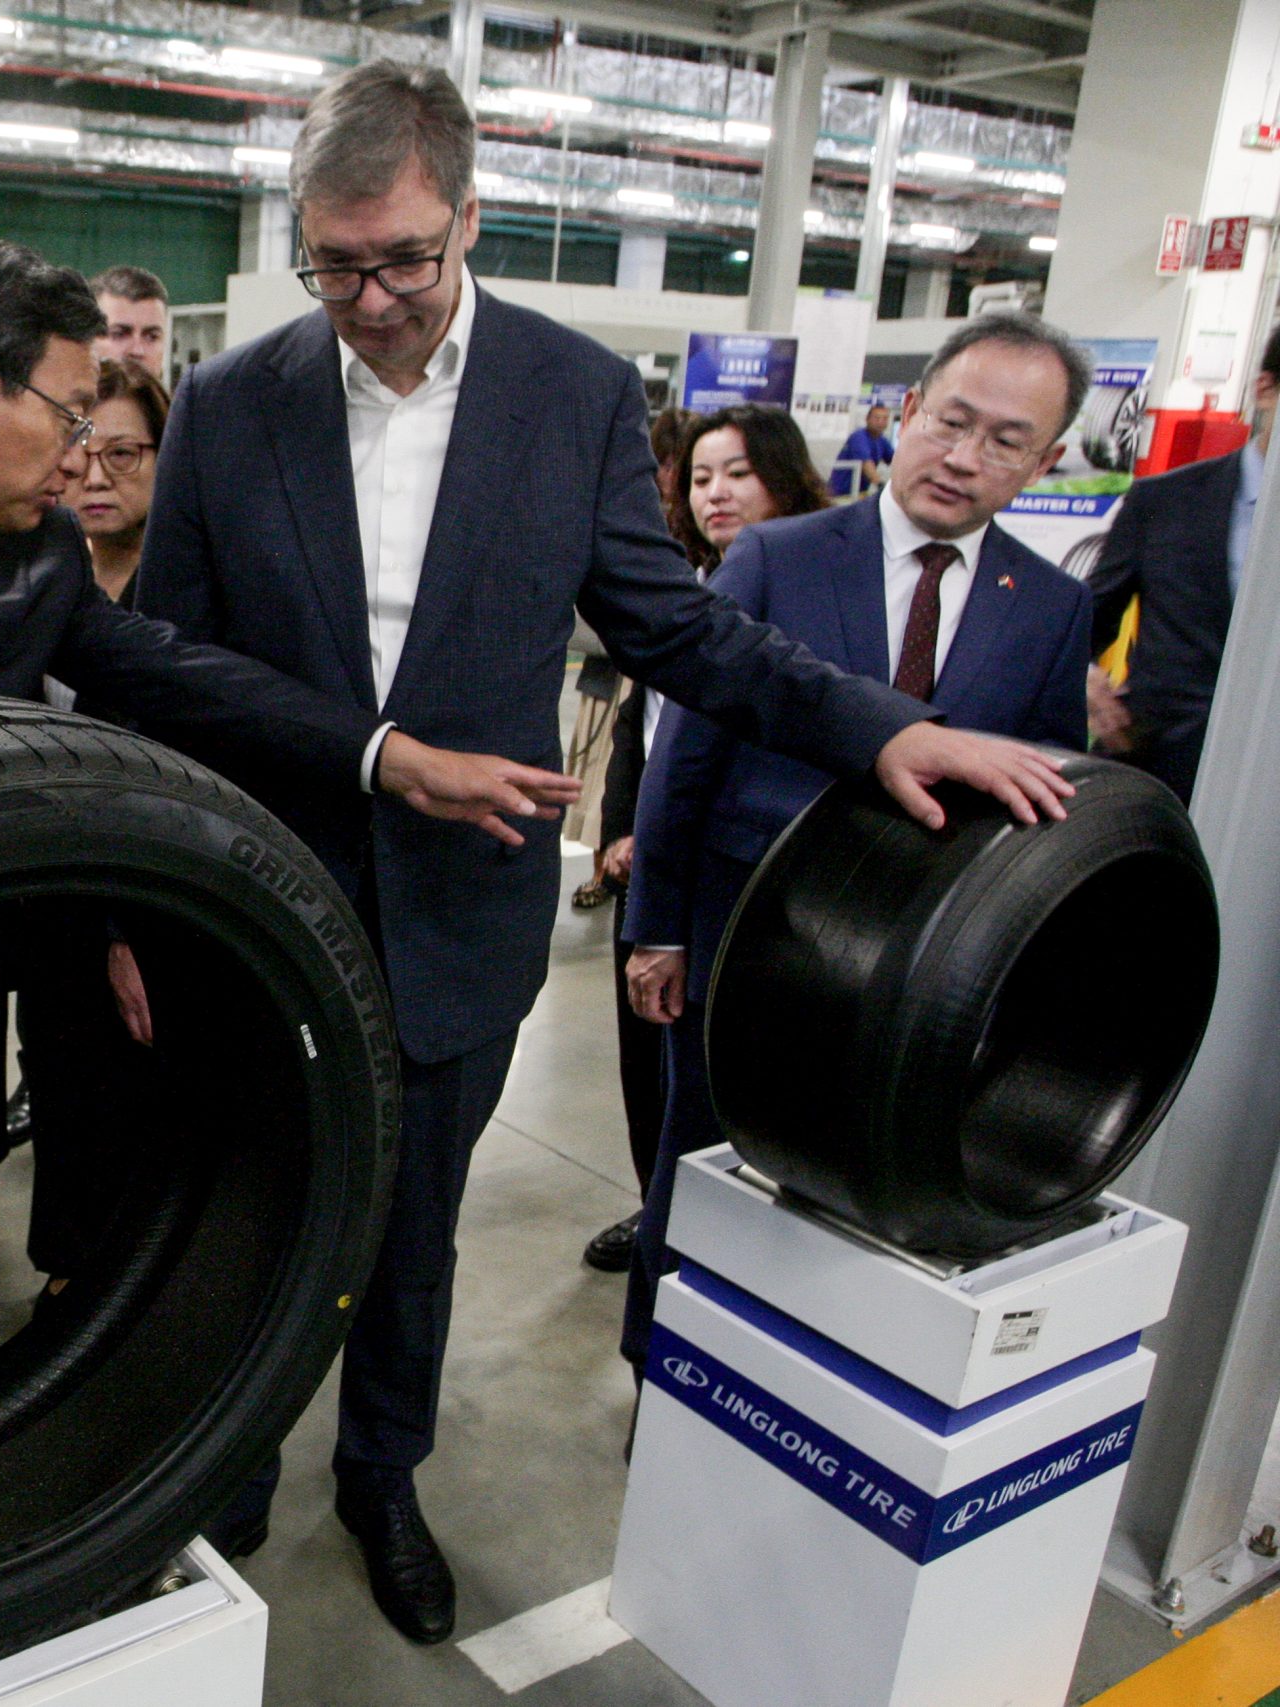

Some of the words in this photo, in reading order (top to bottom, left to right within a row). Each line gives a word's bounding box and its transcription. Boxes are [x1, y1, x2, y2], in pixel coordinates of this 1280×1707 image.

[1010, 497, 1070, 512] MASTER
[228, 835, 318, 905] GRIP
[314, 911, 391, 1085] MASTER
[711, 1384, 840, 1477] LINGLONG
[843, 1470, 917, 1529] TIRE
[985, 1449, 1084, 1513] LINGLONG
[1085, 1425, 1132, 1464] TIRE
